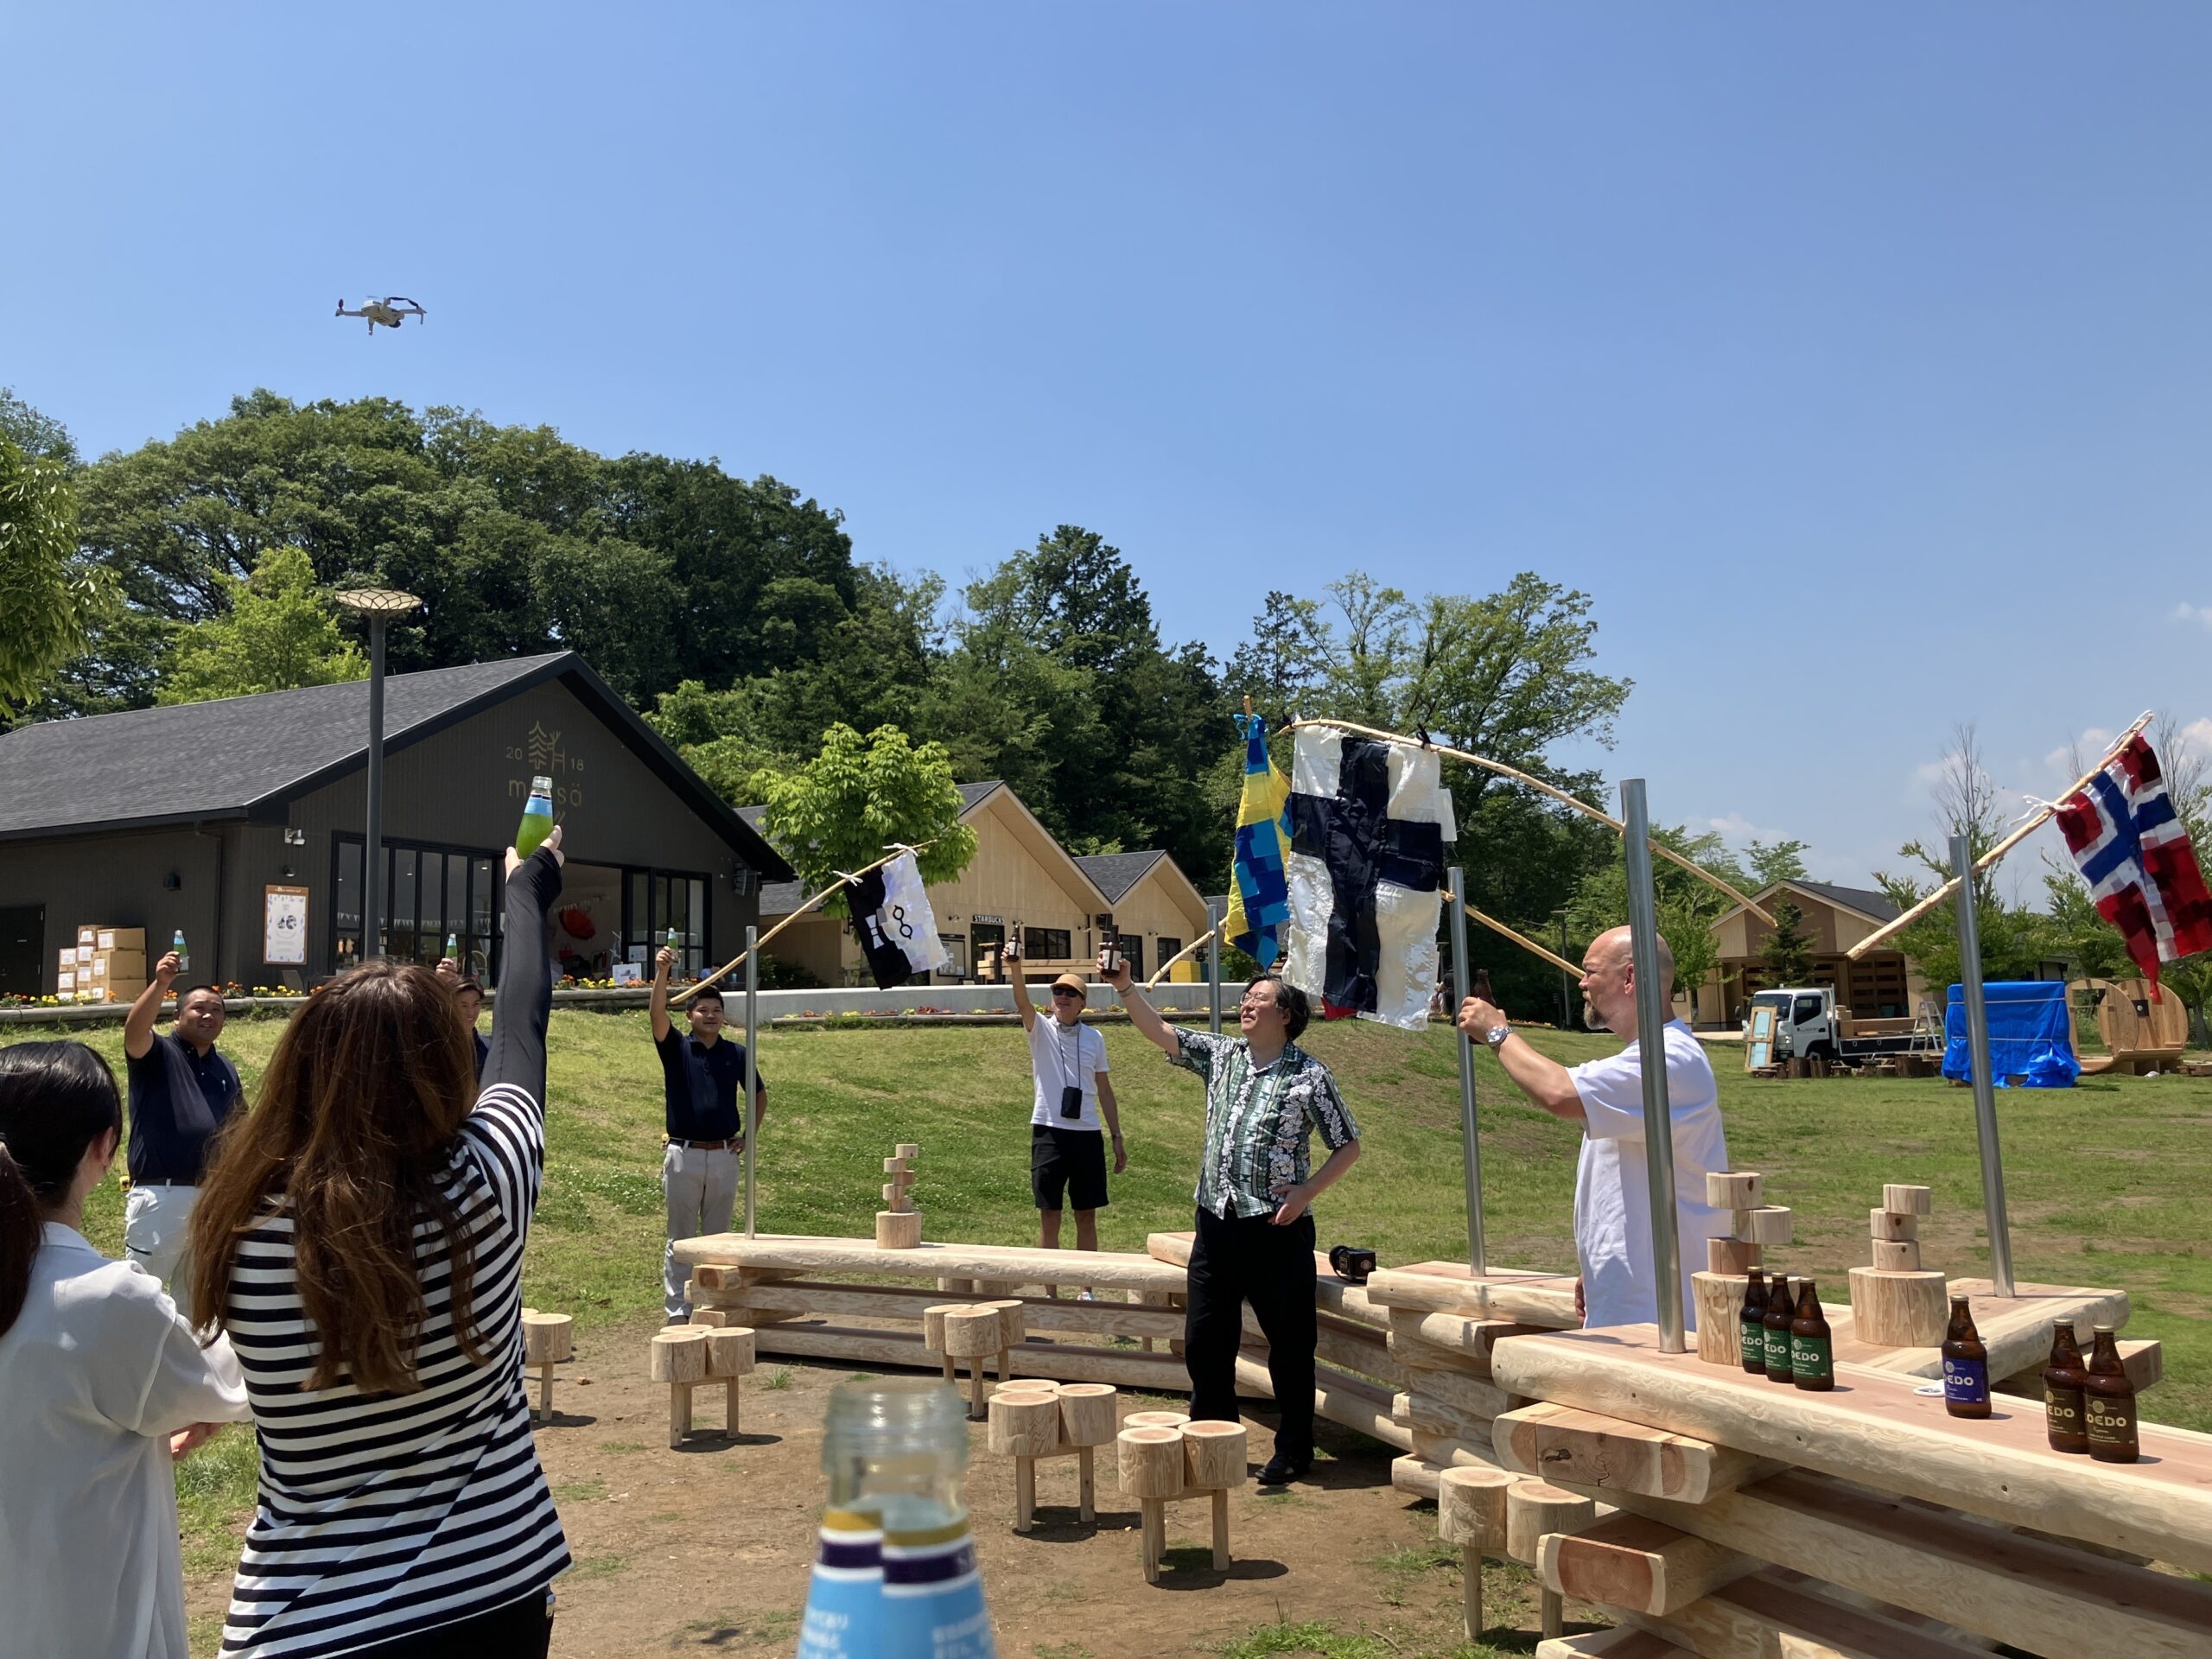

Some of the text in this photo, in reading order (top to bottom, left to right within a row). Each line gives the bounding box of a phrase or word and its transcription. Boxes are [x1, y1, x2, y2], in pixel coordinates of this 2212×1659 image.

[505, 747, 584, 771] 20 18
[509, 779, 582, 806] msä
[975, 915, 1004, 924] STARBUCKS
[1742, 1336, 1763, 1345] EDO
[1764, 1344, 1786, 1354] EDO
[1791, 1350, 1820, 1362] OEDO
[1943, 1373, 1974, 1387] OEDO
[2047, 1405, 2075, 1418] EDO
[2086, 1413, 2127, 1427] OEDO
